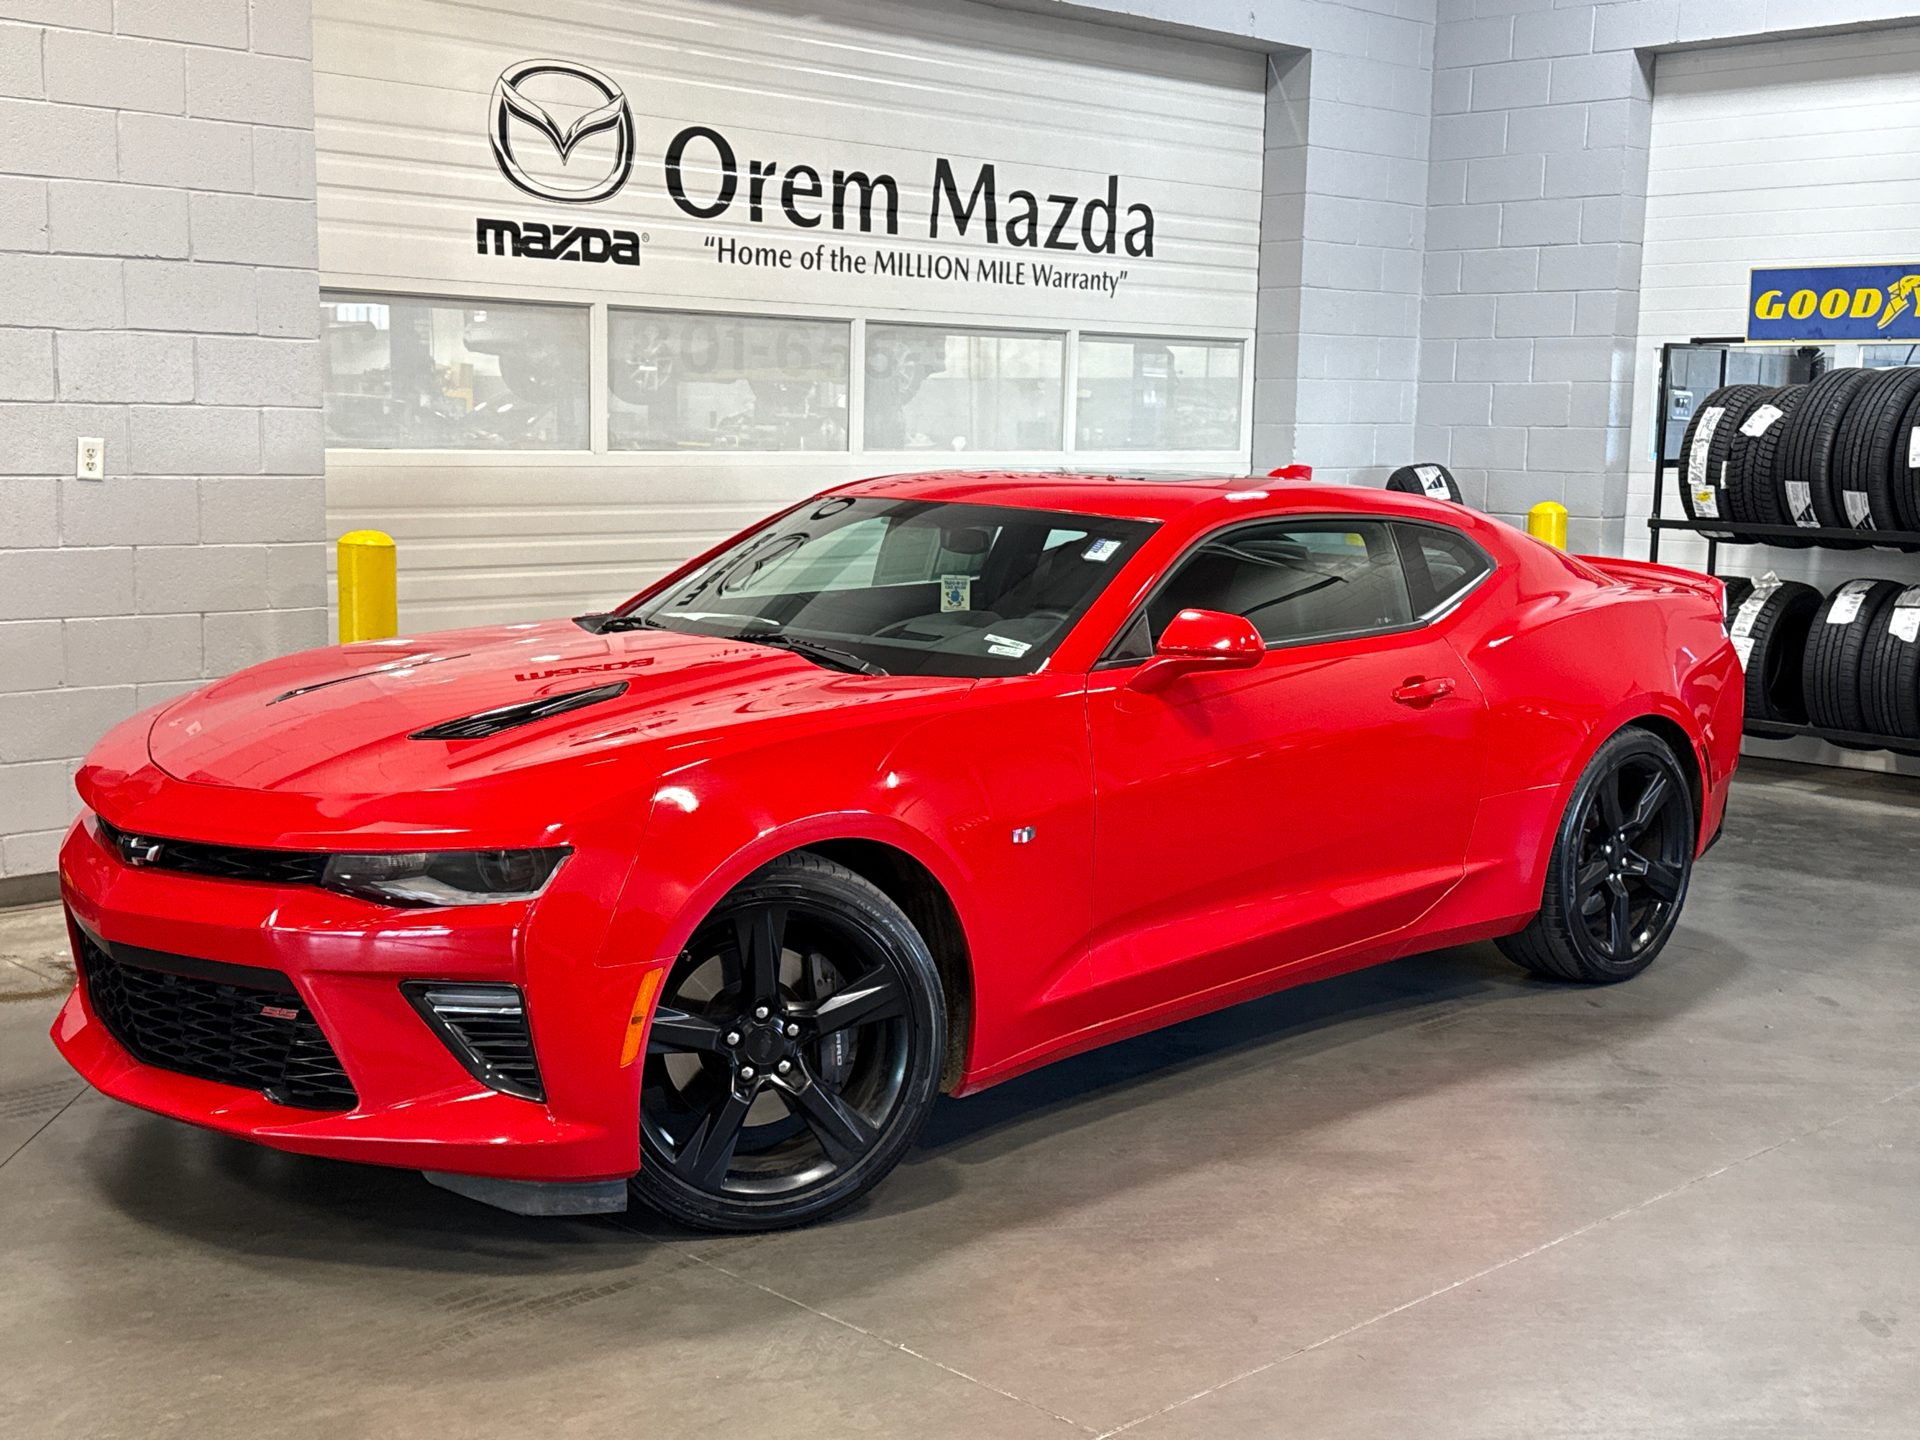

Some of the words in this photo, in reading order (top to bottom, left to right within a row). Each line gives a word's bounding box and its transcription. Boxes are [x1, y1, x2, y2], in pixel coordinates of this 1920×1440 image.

[664, 125, 899, 235] Orem
[929, 157, 1155, 258] Mazda
[476, 217, 641, 266] mazda
[703, 235, 793, 269] “Home
[799, 244, 826, 271] of
[830, 246, 867, 274] the
[873, 250, 970, 282] MILLION
[976, 258, 1026, 286] MILE
[1031, 262, 1128, 299] Warranty”
[1754, 287, 1920, 320] GOOD
[260, 1006, 299, 1019] SS
